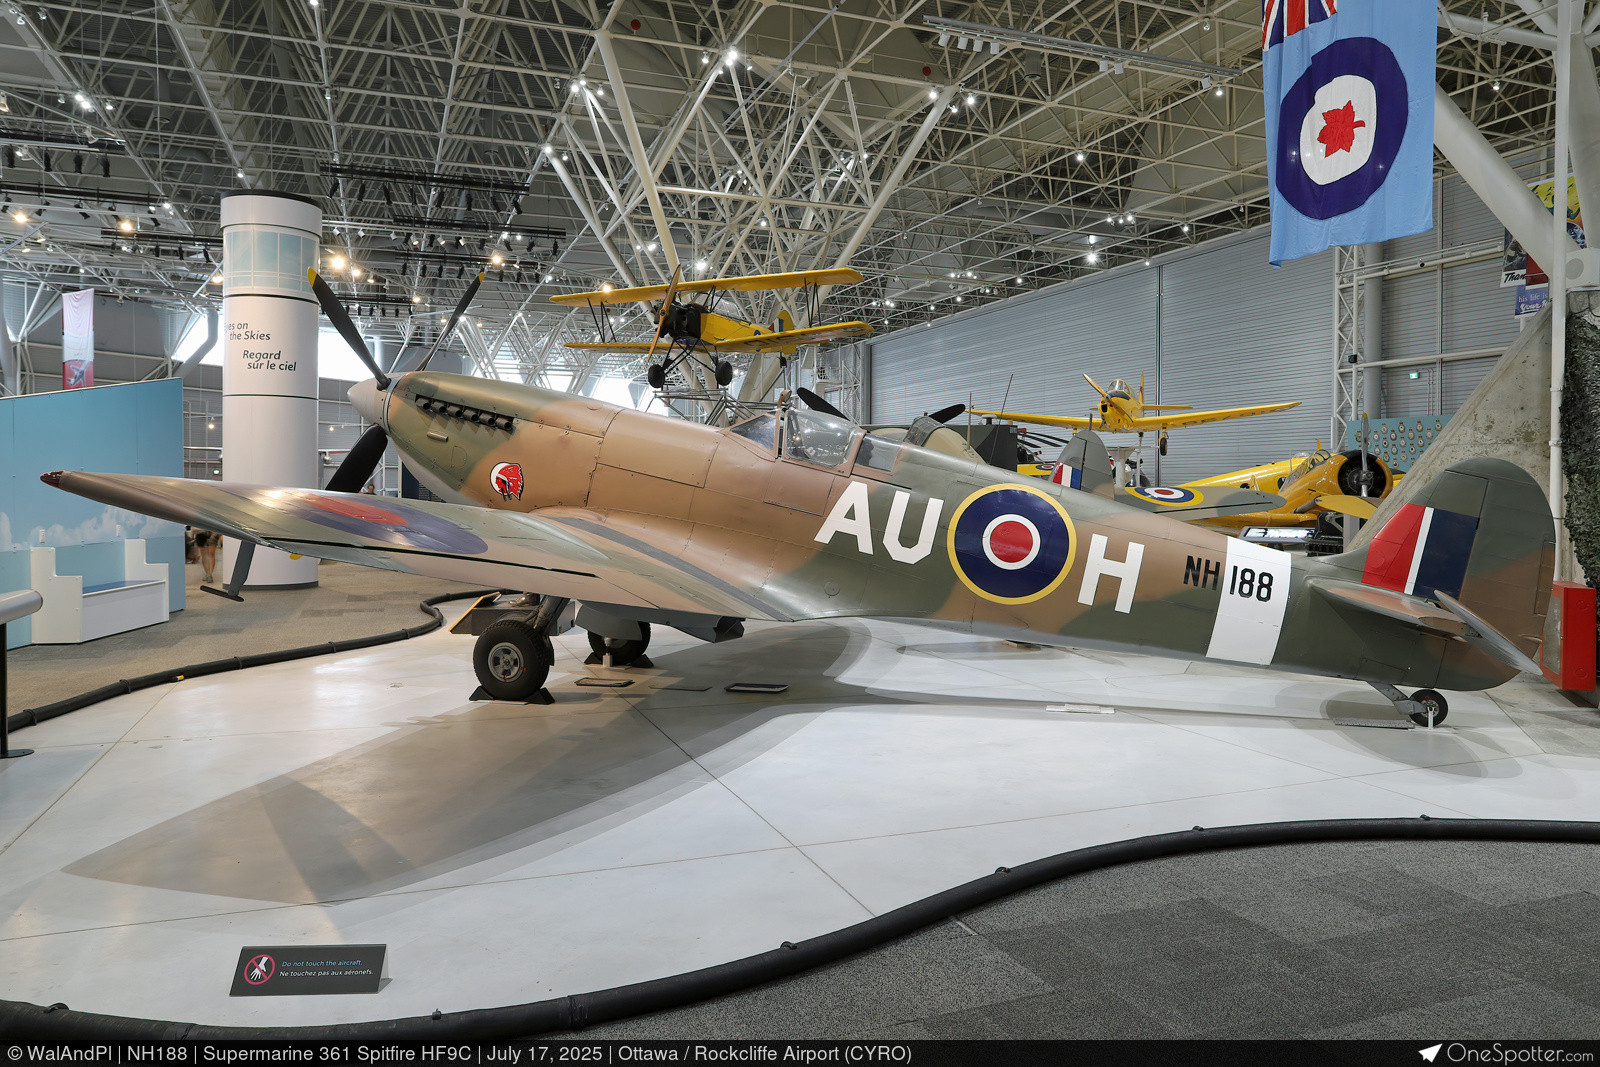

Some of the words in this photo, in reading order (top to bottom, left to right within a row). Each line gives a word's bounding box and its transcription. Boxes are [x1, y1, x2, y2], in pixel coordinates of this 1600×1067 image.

[1504, 272, 1526, 283] Than
[236, 322, 249, 330] on
[229, 331, 242, 341] the
[243, 330, 271, 341] Skies
[242, 350, 282, 362] Regard
[247, 362, 264, 370] sur
[266, 360, 276, 370] le
[278, 361, 297, 371] ciel
[813, 480, 945, 565] AU
[1077, 533, 1145, 614] H
